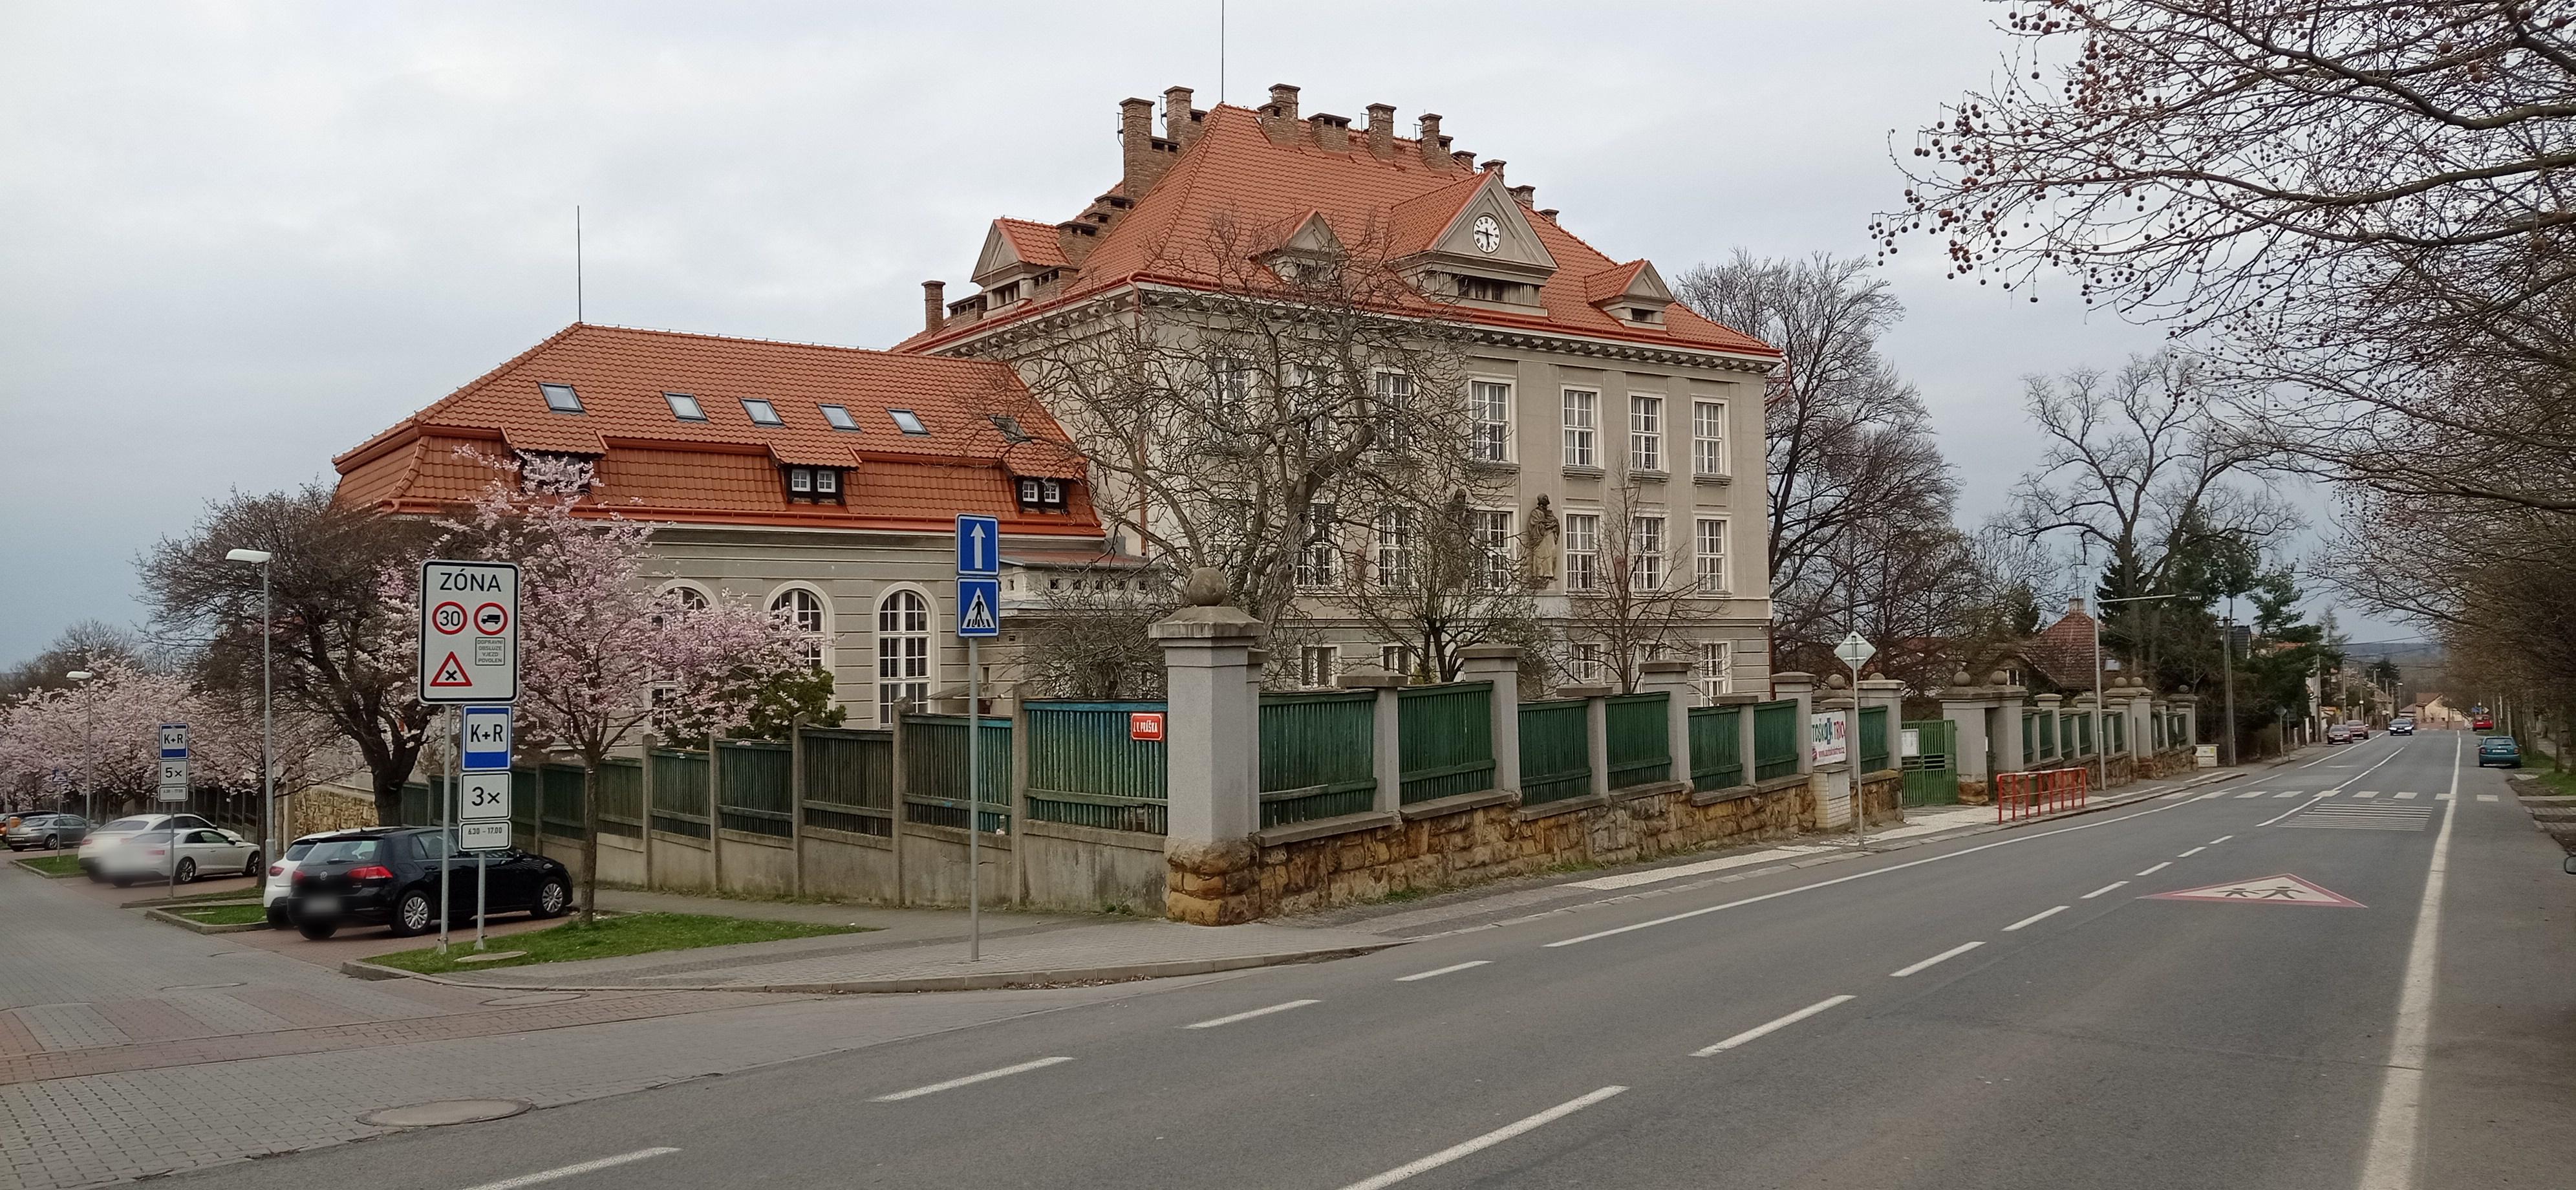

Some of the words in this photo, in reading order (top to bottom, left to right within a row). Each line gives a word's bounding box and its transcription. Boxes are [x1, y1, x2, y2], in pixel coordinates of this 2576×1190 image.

[440, 568, 502, 592] ZÓNA
[439, 610, 460, 627] 30
[164, 733, 184, 744] K+R
[470, 724, 503, 742] K+R
